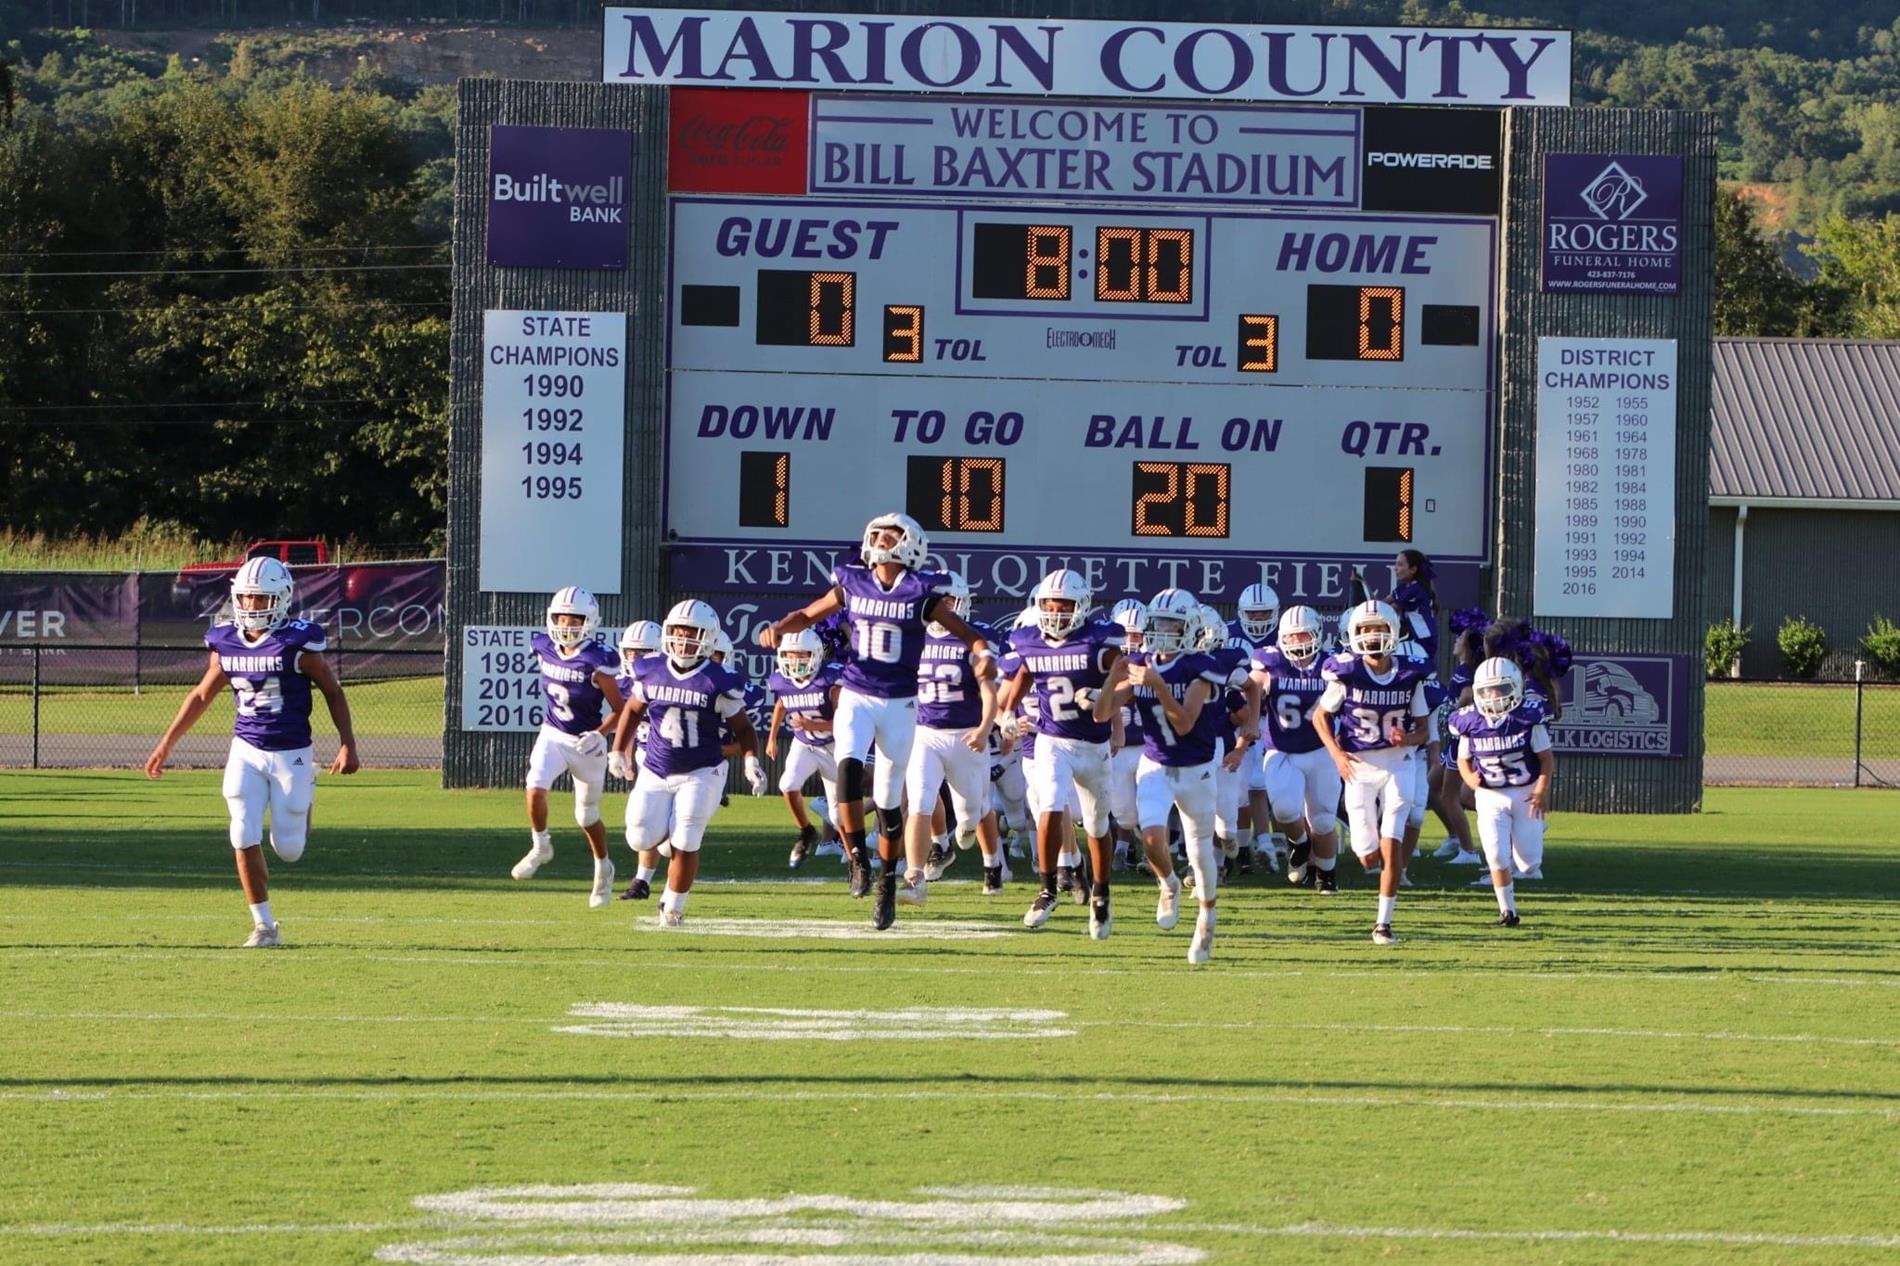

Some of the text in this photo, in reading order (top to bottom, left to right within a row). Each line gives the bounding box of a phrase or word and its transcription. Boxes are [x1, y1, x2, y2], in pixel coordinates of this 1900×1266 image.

[619, 14, 1556, 101] MARION COUNTY
[951, 108, 1219, 145] WELCOME TO
[823, 142, 1346, 197] BILL BAXTER STADIUM
[1368, 152, 1492, 170] POWERADE
[494, 173, 623, 205] Builtwell
[570, 206, 622, 223] BANK
[715, 216, 900, 260] GUEST
[1549, 223, 1678, 252] ROGERS
[1025, 225, 1192, 303] 8:00
[1276, 232, 1439, 275] HOME
[1554, 255, 1672, 268] FUNERAL HOME
[810, 272, 853, 345] 0
[522, 316, 591, 337] STATE
[887, 306, 919, 362] 3
[1359, 287, 1402, 360] 0
[933, 338, 986, 362] TOL
[1242, 316, 1274, 371] 3
[490, 345, 619, 367] CHAMPIONS
[1175, 345, 1227, 368] TOL
[1561, 349, 1655, 366] DISTRICT
[523, 374, 584, 398] 1990
[1545, 372, 1670, 390] CHAMPIONS
[1567, 396, 1648, 409] 1952 1955
[522, 408, 583, 432] 1992
[697, 404, 836, 441] DOWN
[890, 409, 1024, 446] TO GO
[1567, 413, 1648, 426] 1957 1960
[1084, 414, 1283, 452] BALL ON
[1341, 420, 1443, 458] QTR.
[1567, 430, 1648, 443] 1961 1964
[522, 442, 583, 466] 1994
[1567, 447, 1648, 460] 1968 1978
[1567, 464, 1646, 477] 1980 1981
[521, 476, 582, 500] 1995
[774, 454, 787, 526] 1
[941, 458, 1002, 531] 10
[1566, 481, 1646, 493] 1982 1984
[1135, 462, 1229, 537] 20
[1398, 469, 1411, 541] 1
[1566, 498, 1647, 511] 1985 1988
[1565, 515, 1646, 528] 1989 1990
[1565, 532, 1646, 545] 1991 1992
[1565, 549, 1645, 561] 1993 1994
[1564, 566, 1645, 578] 1995 2014
[1562, 583, 1596, 595] 2016
[851, 596, 914, 620] WARRIORS
[467, 630, 524, 646] STATE
[855, 619, 903, 663] 10
[221, 656, 283, 672] WARRIORS
[481, 652, 541, 674] 1982
[1025, 654, 1088, 673] WARRIORS
[231, 677, 284, 716] 24
[479, 678, 542, 700] 2014
[647, 685, 709, 708] WARRIORS
[1047, 676, 1080, 722] 2
[1352, 688, 1411, 705] WARRIORS
[547, 683, 574, 722] 3
[478, 704, 543, 726] 2016
[660, 706, 699, 748] 41
[1580, 731, 1667, 749] LOGISTICS
[1480, 752, 1531, 787] 55
